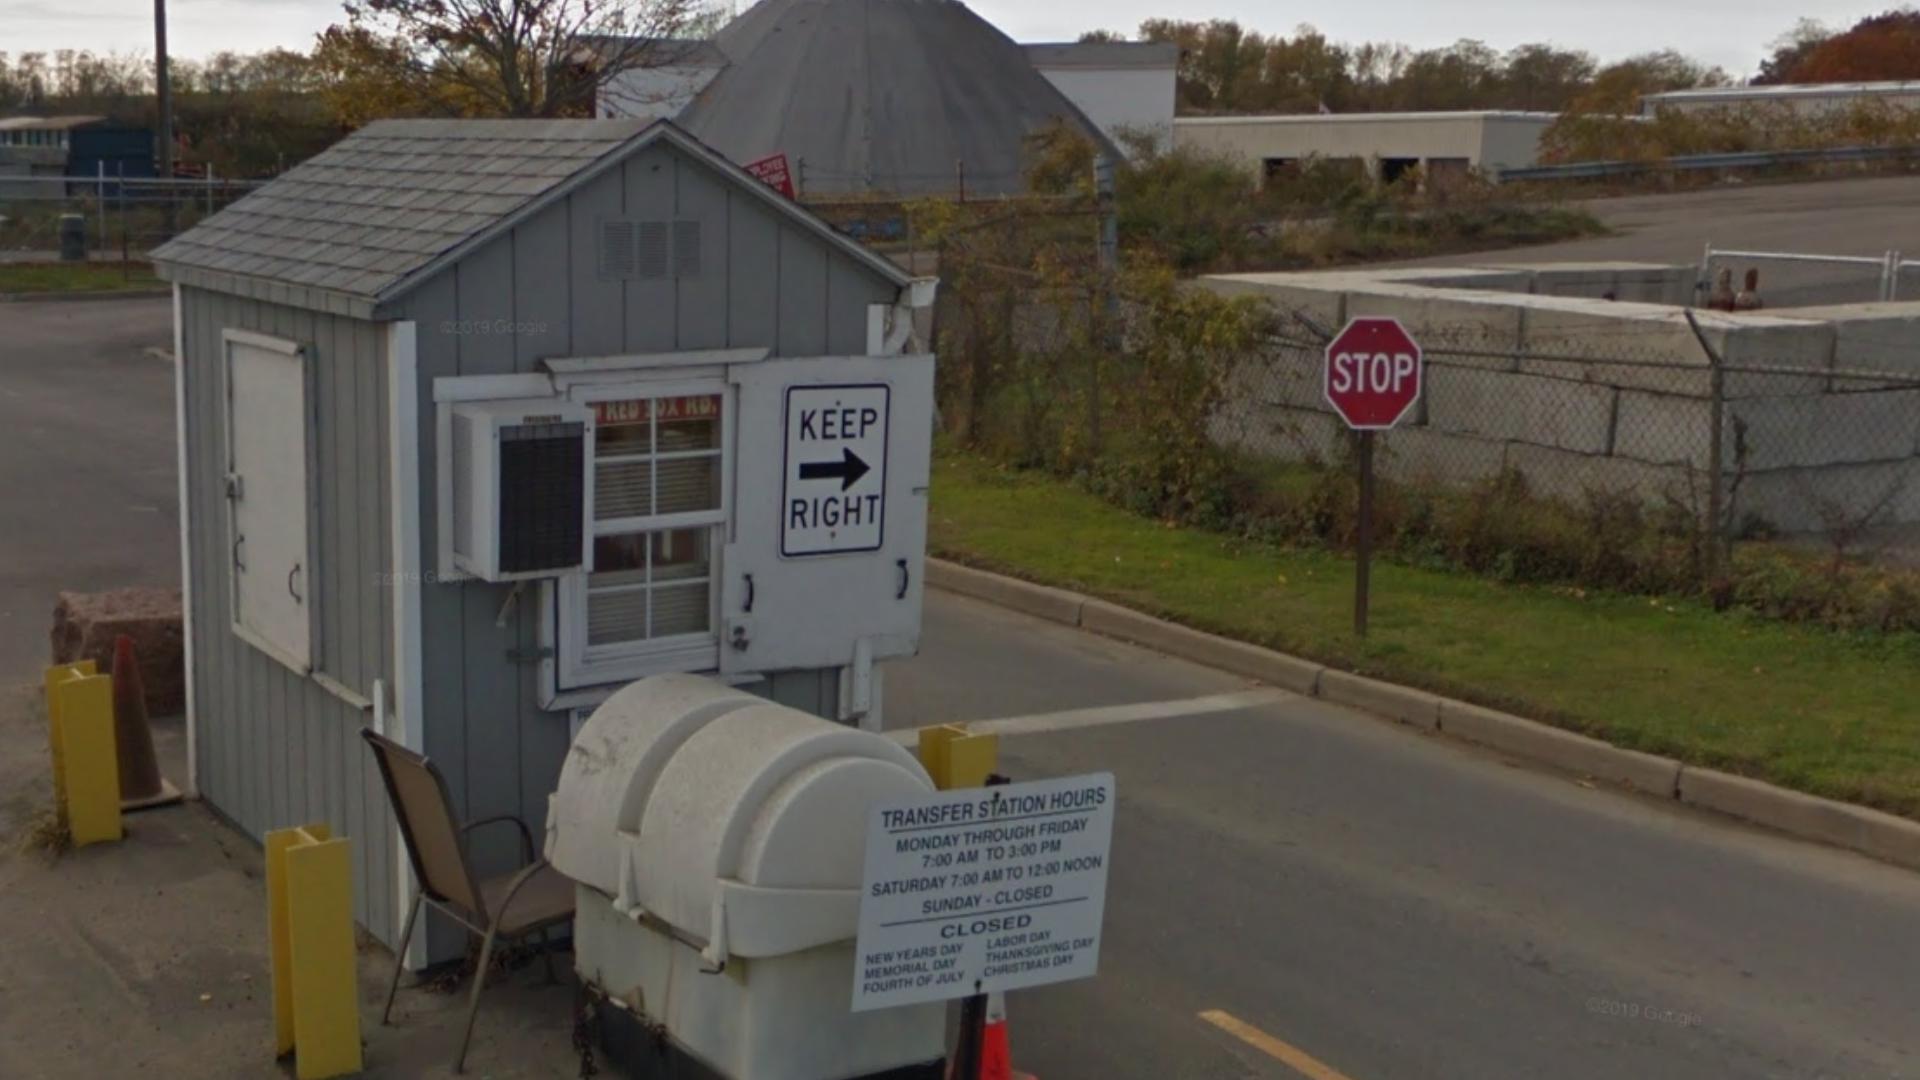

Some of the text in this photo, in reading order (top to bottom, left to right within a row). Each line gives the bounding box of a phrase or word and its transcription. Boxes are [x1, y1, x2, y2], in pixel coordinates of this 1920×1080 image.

[1333, 352, 1414, 393] STOP
[800, 408, 878, 441] KEEP
[790, 494, 880, 530] RIGHT
[881, 786, 1107, 828] TRANSFER STATION HOURS
[895, 817, 1089, 853] MONDAY THROUGH FRIDAY
[922, 838, 1062, 869] 7:00 AM TO 3:00 PM
[871, 856, 1103, 897] SATURDAY 7:00 AM TO 12:00 NOON
[921, 894, 981, 916] SUNDAY
[994, 884, 1054, 905] CLOSED
[940, 914, 1032, 939] CLOSED
[986, 929, 1052, 950] LABOR DAY
[865, 942, 964, 966] NEW YEARS DAY
[985, 936, 1095, 964] THANKSGIVING DAY
[864, 958, 957, 980] MEMORIAL DAY
[983, 954, 1075, 978] CHRISTMAS DAY
[862, 971, 966, 995] FOURTH OF JULY
